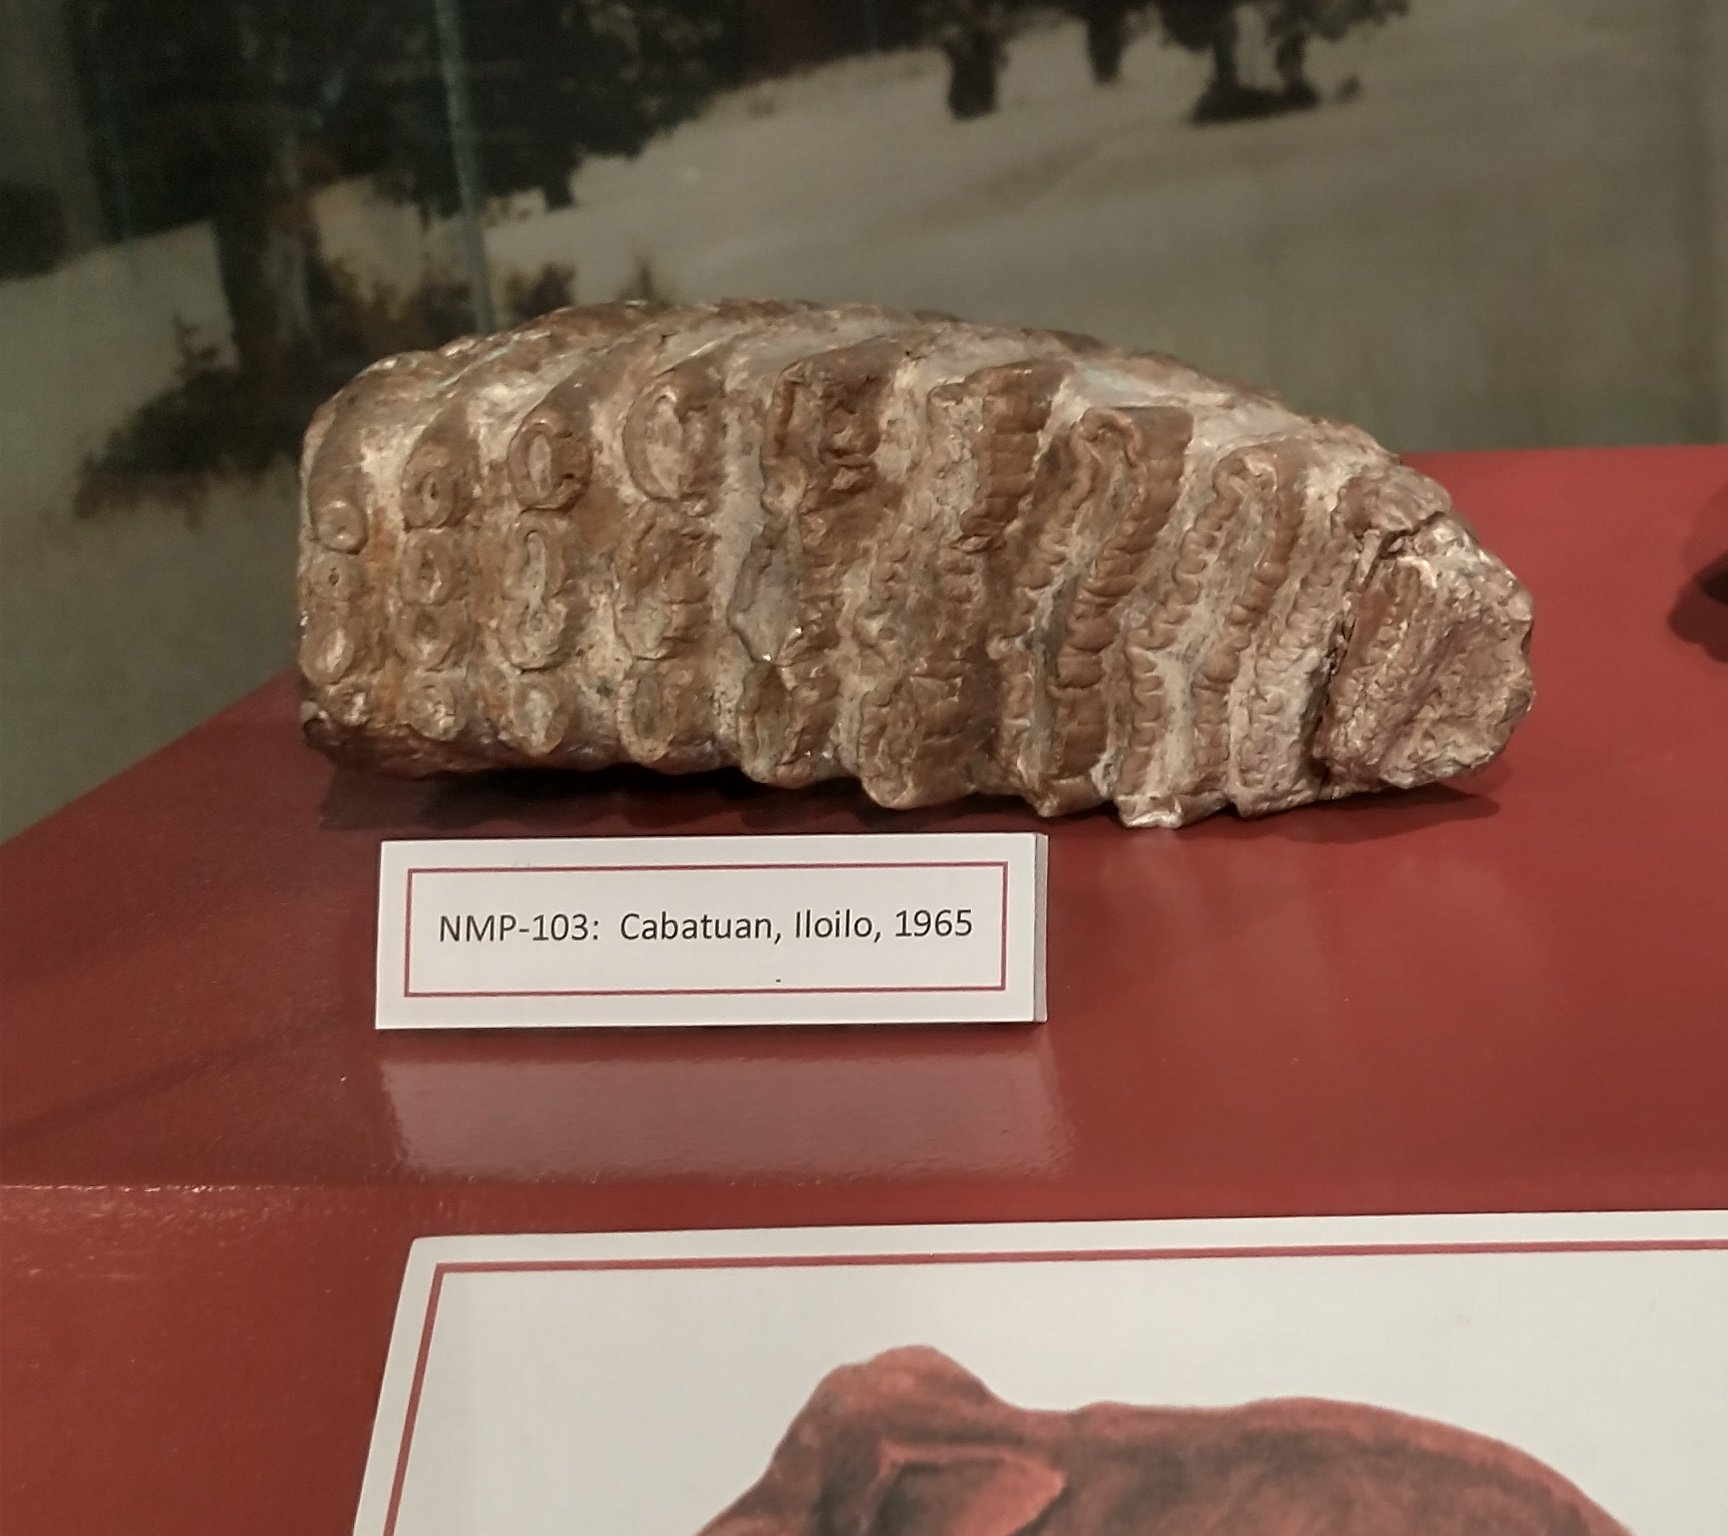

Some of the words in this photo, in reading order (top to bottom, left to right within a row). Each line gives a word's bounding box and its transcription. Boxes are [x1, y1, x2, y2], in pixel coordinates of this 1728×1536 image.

[440, 913, 599, 942] NMP-103:
[620, 911, 781, 945] Cabatuan,
[795, 908, 881, 943] Iloilo,
[895, 909, 972, 937] 1965
